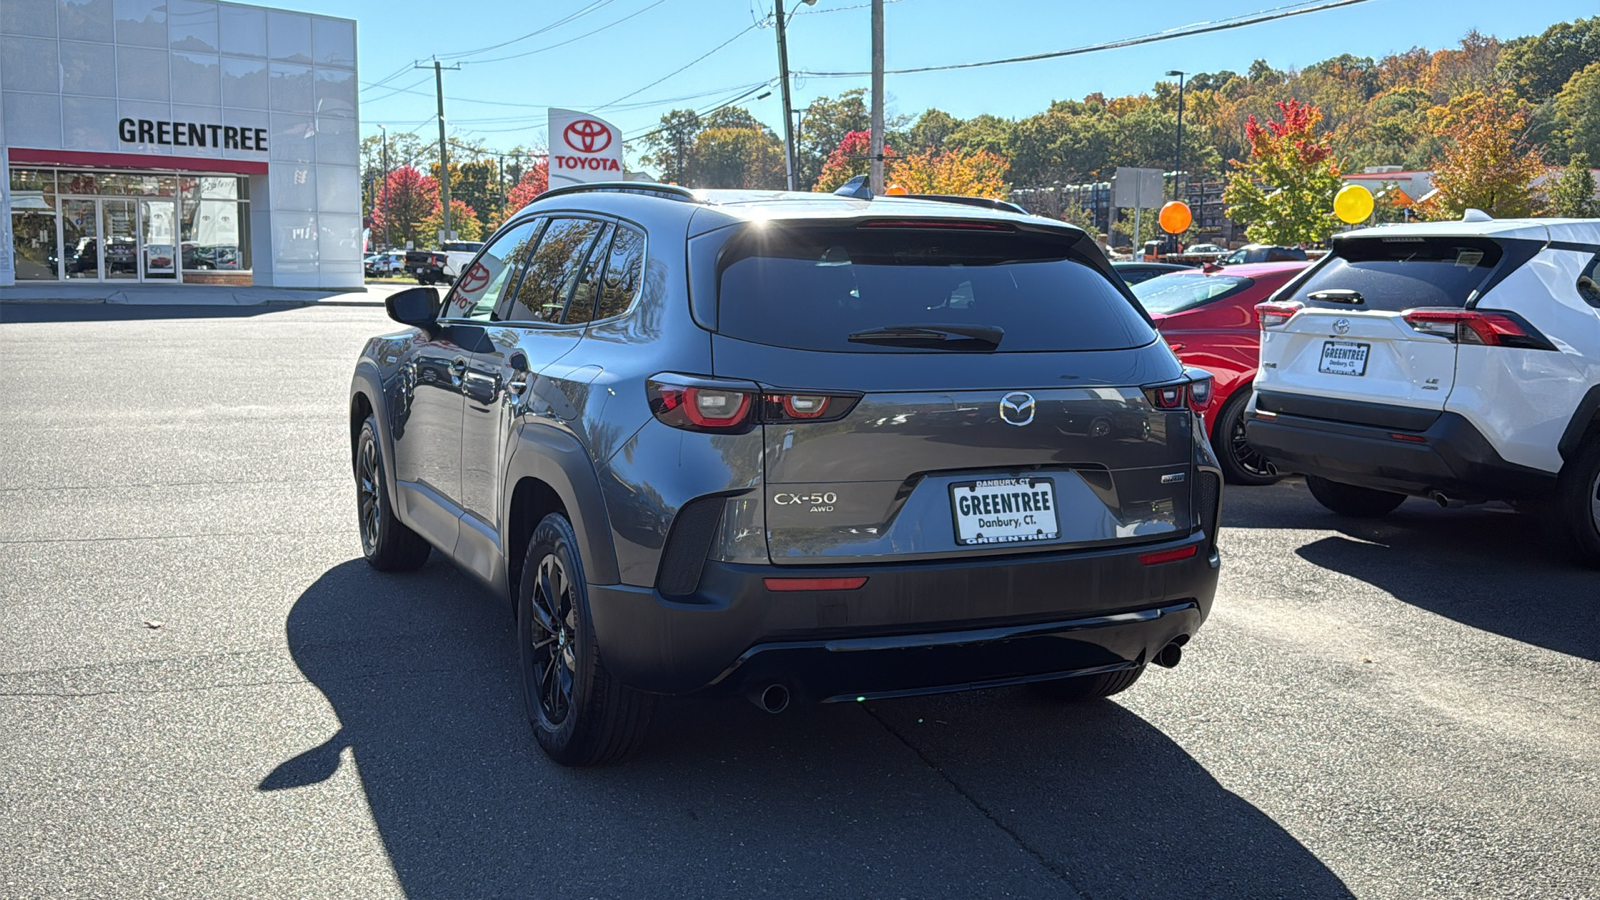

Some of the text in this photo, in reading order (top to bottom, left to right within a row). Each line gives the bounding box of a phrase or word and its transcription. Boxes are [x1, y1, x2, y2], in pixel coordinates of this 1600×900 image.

[118, 118, 268, 151] GREENTREE
[554, 156, 620, 171] TOYOTA
[1324, 347, 1366, 361] GREENTREE
[1020, 478, 1030, 486] CT
[774, 492, 837, 505] CX-50
[959, 491, 1051, 516] GREENTREE
[978, 515, 1036, 529] Danbury, CT.
[966, 533, 1057, 545] GREENTREE
